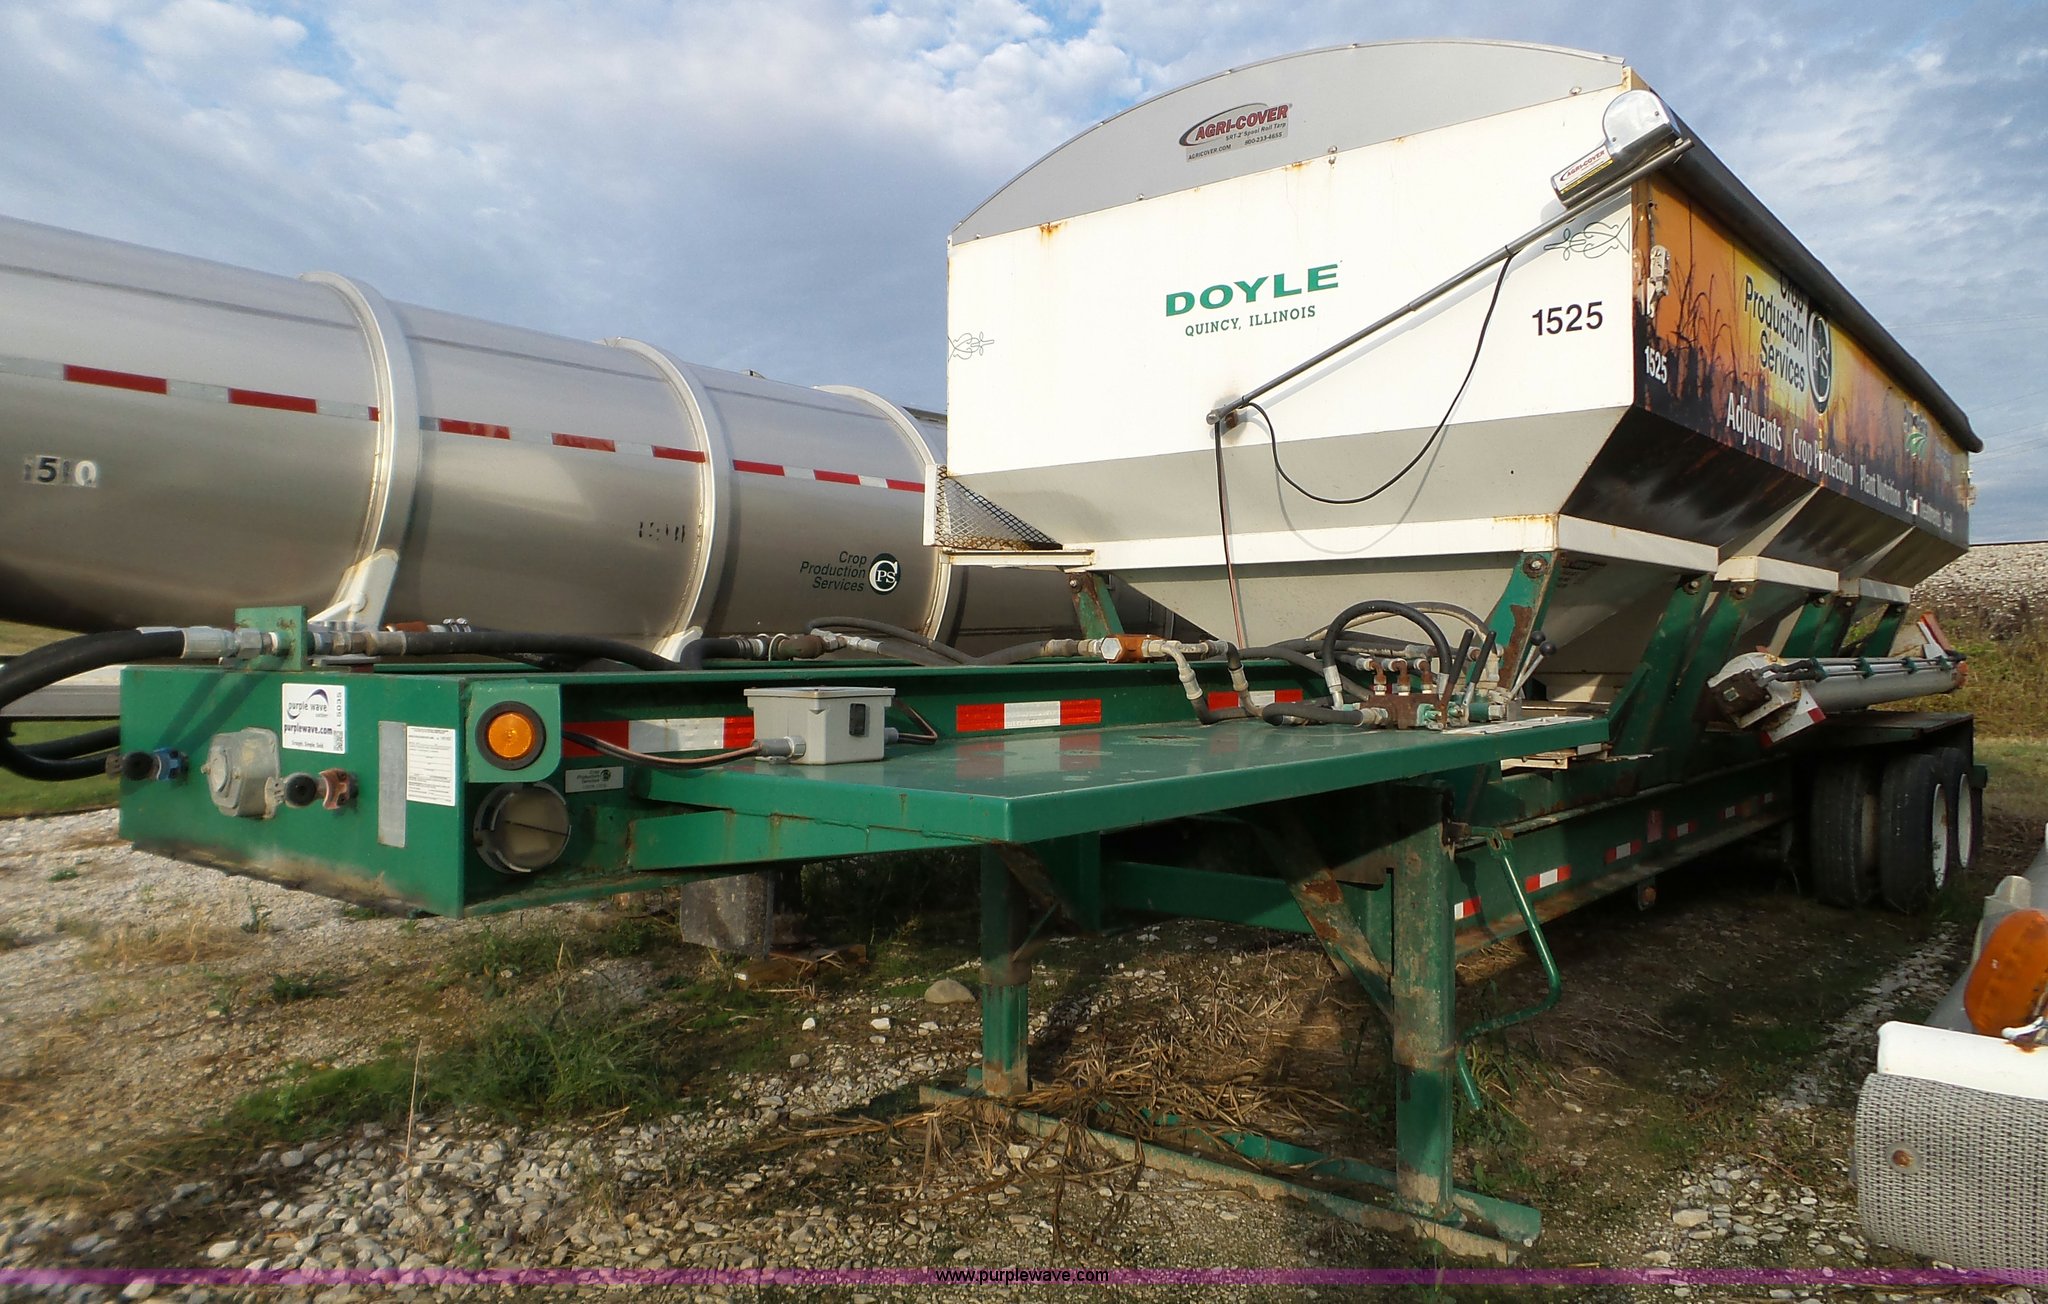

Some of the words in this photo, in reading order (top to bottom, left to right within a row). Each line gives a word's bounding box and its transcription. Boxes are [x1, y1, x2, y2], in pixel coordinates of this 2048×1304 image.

[1195, 104, 1289, 141] AGRI-COVER
[1166, 264, 1339, 317] DOYLE
[1185, 317, 1242, 337] QUINCY,
[1249, 305, 1316, 327] ILLINOIS
[1532, 301, 1603, 336] 1525
[1744, 275, 1805, 353] Production
[1644, 345, 1667, 384] 1525
[1760, 330, 1805, 392] Services
[1726, 392, 1782, 451] Adjuvants
[1793, 428, 1812, 474] Crop
[799, 561, 866, 578] Production
[839, 551, 867, 568] Crop
[812, 576, 865, 592] Services
[284, 722, 333, 735] purplewave.com
